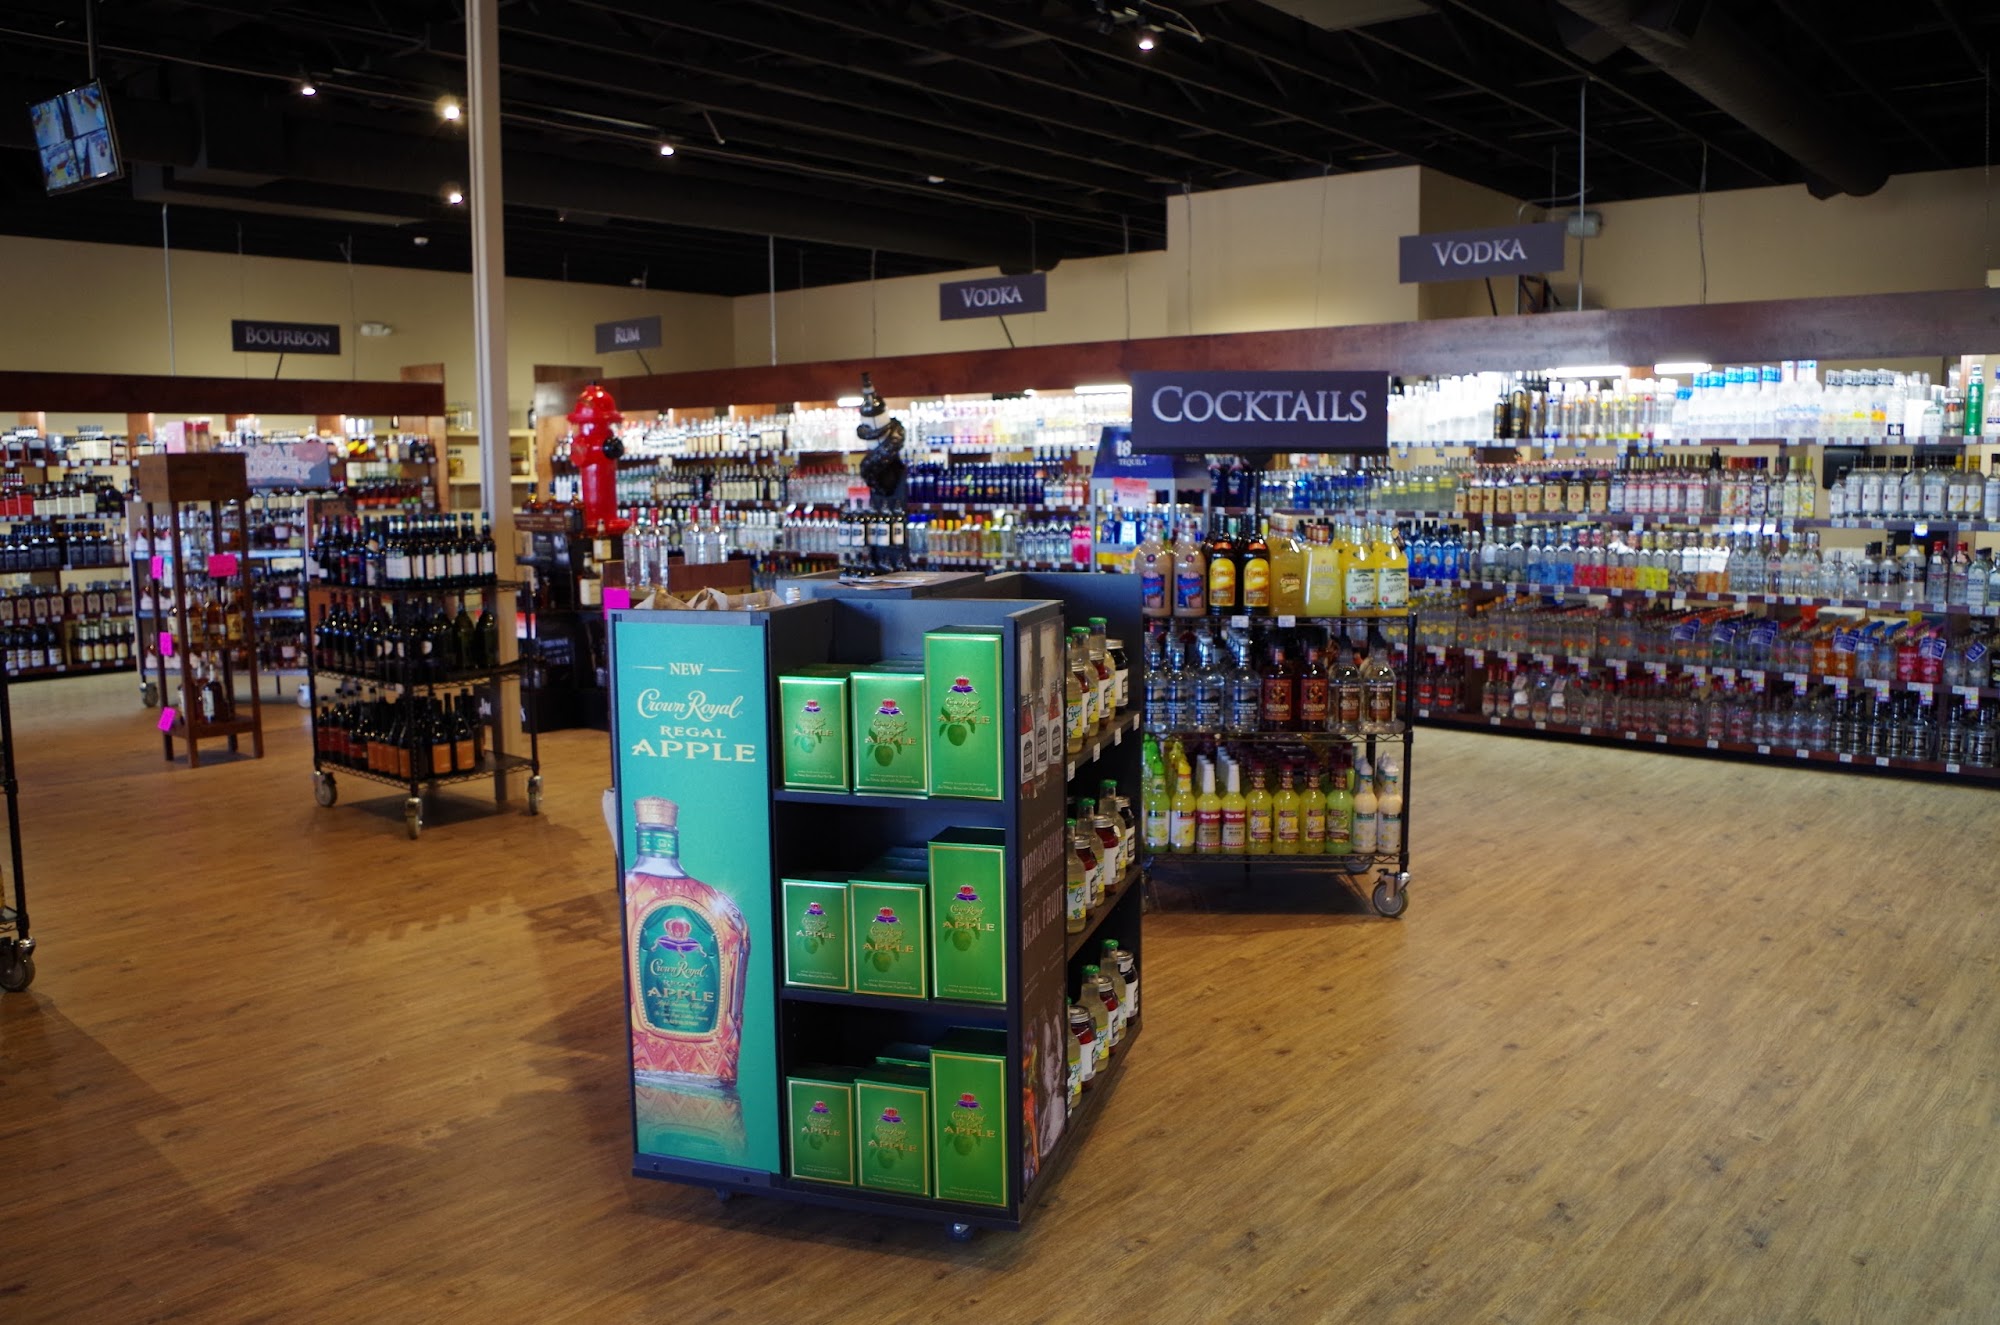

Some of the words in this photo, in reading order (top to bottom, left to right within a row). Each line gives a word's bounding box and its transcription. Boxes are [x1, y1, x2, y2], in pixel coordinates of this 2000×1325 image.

[1432, 238, 1528, 267] VODKA
[961, 285, 1023, 308] VODKA
[245, 326, 331, 347] BOURBON
[615, 326, 641, 344] RUM
[1152, 385, 1368, 422] COCKTAILS
[669, 662, 704, 675] NEW
[637, 688, 686, 719] Crown
[674, 690, 744, 722] Royal
[660, 725, 727, 739] REGAL
[631, 738, 757, 763] APPLE
[1022, 826, 1065, 889] MOONSHINE
[943, 921, 995, 932] APPLE
[1023, 907, 1041, 950] REAL
[1043, 884, 1064, 928] FRUIT
[796, 929, 836, 939] APPLE
[863, 942, 914, 953] APPLE
[650, 958, 678, 976] Crown
[673, 960, 708, 979] Royal
[647, 986, 715, 1003] APPLE
[944, 1126, 996, 1138] APPLE
[868, 1139, 918, 1152] APPLE
